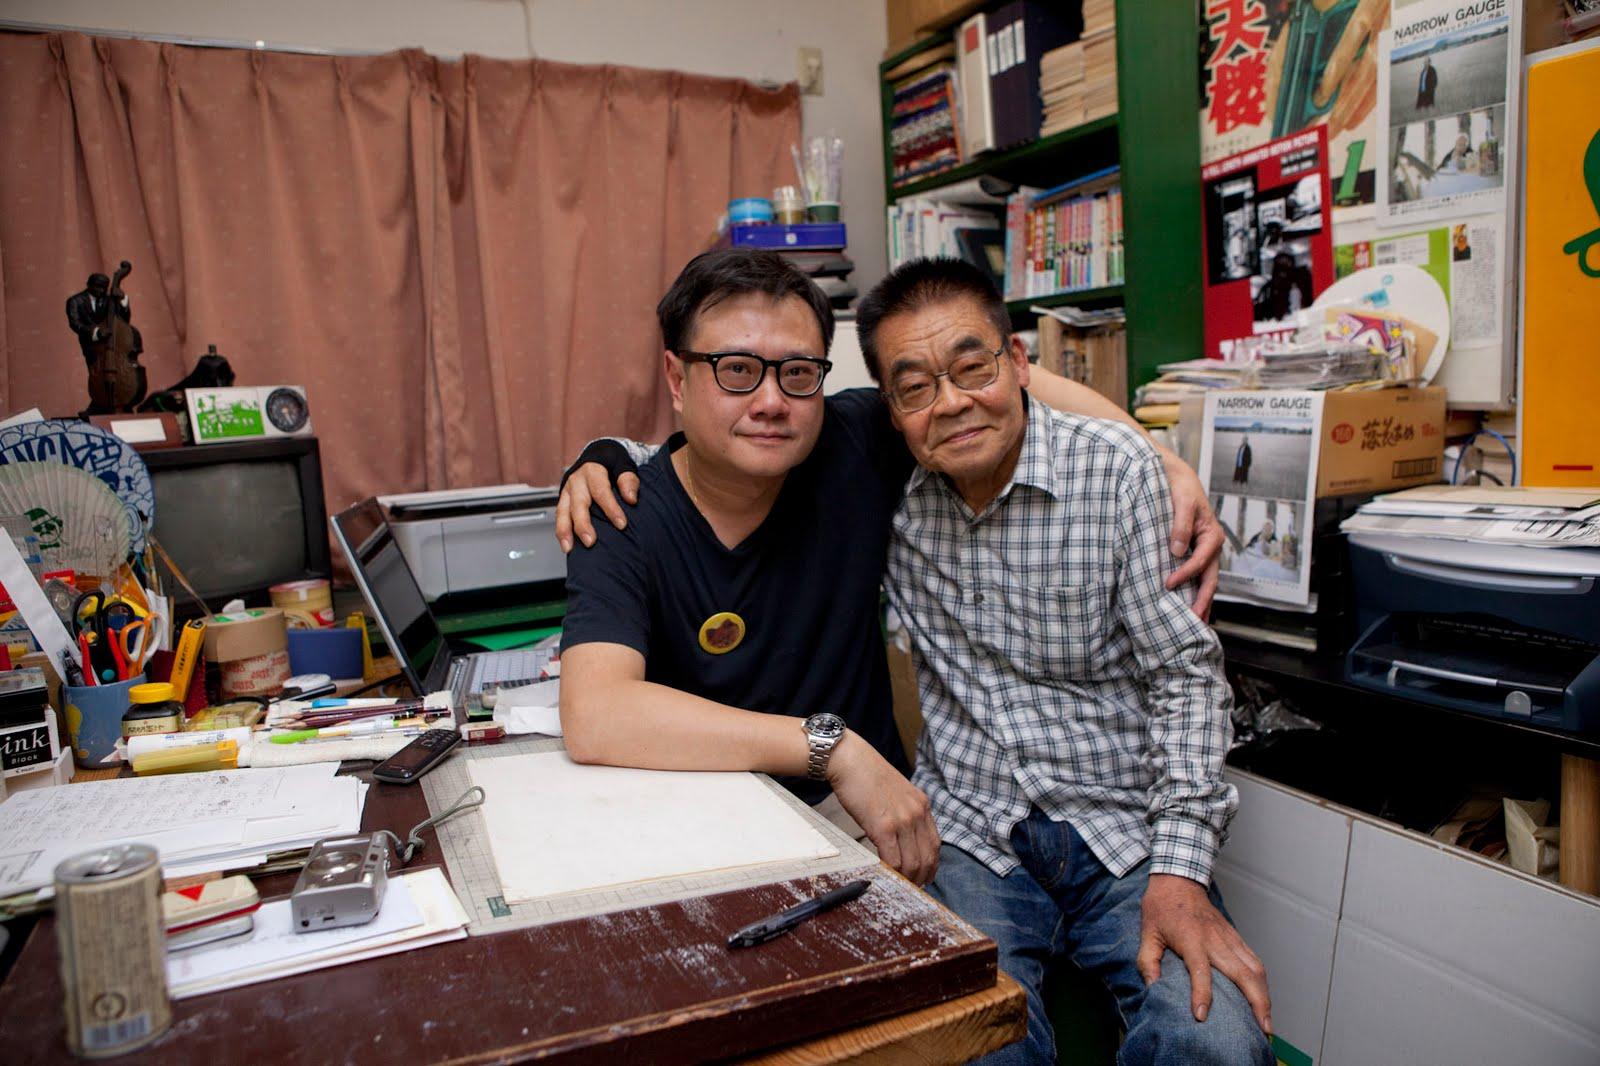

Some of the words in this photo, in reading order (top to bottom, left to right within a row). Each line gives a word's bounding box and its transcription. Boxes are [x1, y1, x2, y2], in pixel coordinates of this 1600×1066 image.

[1394, 14, 1449, 40] NARROW
[1335, 139, 1366, 202] 1
[1217, 397, 1265, 409] NARROW
[1269, 397, 1312, 410] GAUGE
[0, 729, 50, 755] ink
